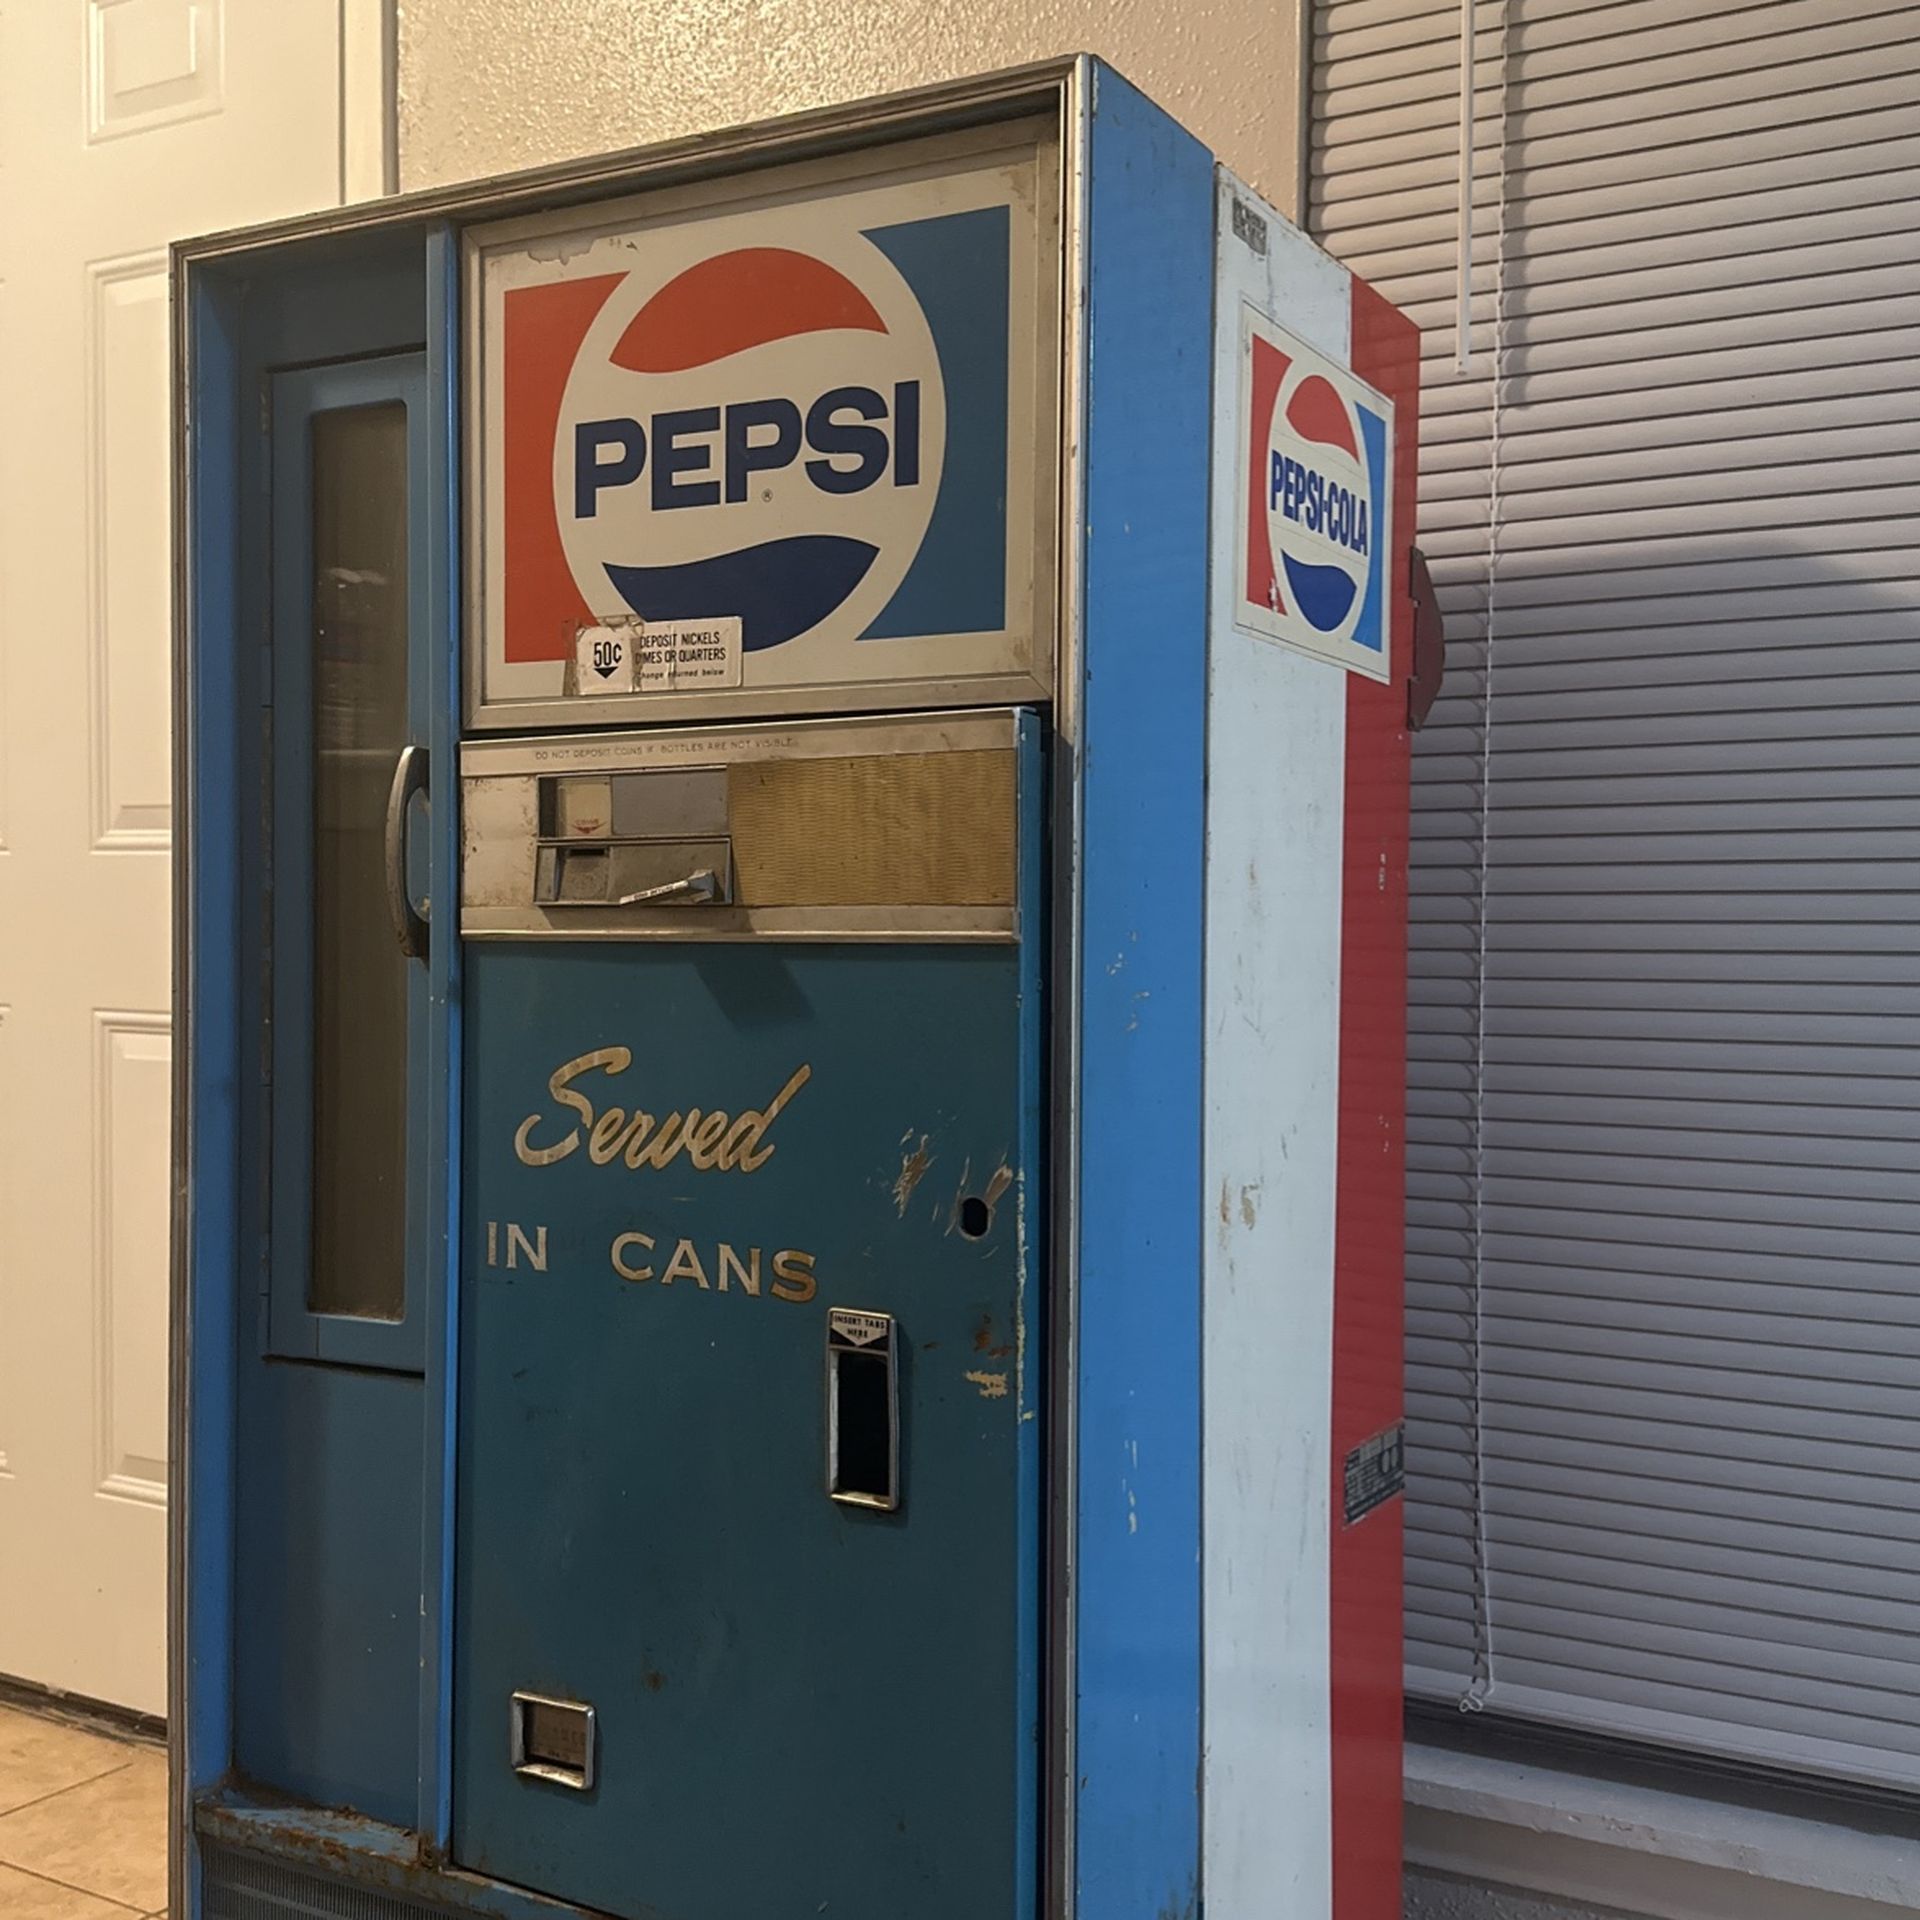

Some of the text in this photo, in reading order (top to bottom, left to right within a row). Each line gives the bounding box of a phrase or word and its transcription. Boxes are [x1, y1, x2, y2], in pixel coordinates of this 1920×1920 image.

[575, 380, 920, 519] PEPSI
[1270, 448, 1368, 557] PEPSI-COLA
[640, 631, 720, 649] DEPOSIT NICKELS
[635, 647, 726, 665] DMES OR QUARTERS
[638, 671, 664, 681] hange
[668, 669, 698, 679] rturned
[536, 751, 548, 760] DO
[552, 749, 569, 759] NOT
[573, 747, 610, 758] DEPOSIT
[614, 746, 642, 756] COINS
[660, 743, 704, 753] BOTTLES
[708, 741, 727, 751] ARE
[731, 740, 751, 749] NOT
[514, 1046, 812, 1173] Served
[486, 1221, 818, 1303] IN CANS
[834, 1315, 886, 1329] INSERT TABS
[847, 1328, 868, 1338] HERE
